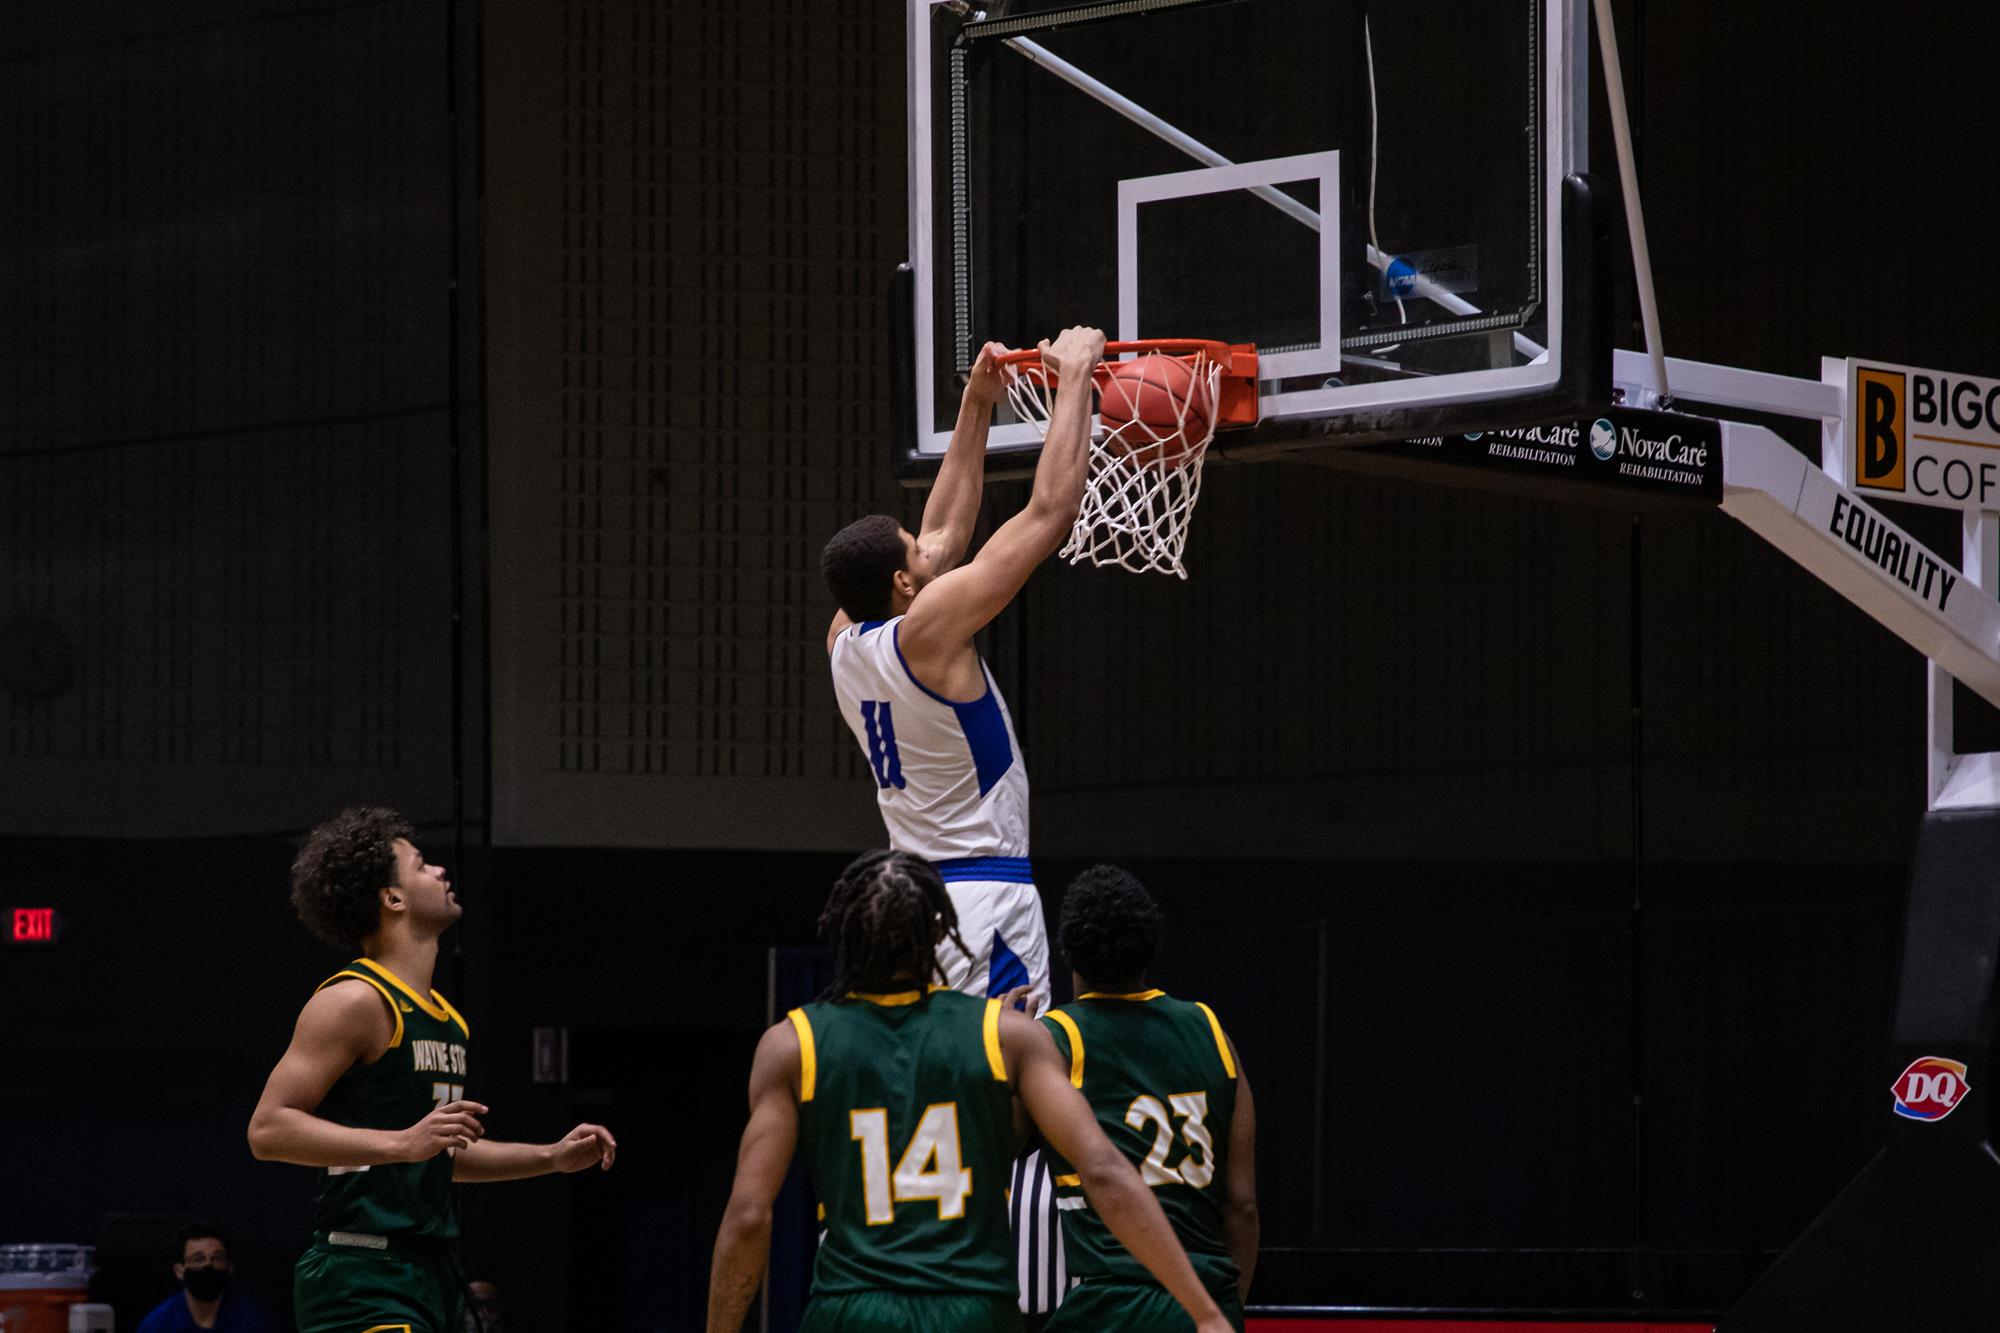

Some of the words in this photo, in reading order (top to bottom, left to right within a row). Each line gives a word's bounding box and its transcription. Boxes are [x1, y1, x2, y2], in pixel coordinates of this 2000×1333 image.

[1487, 426, 1580, 448] vaCare
[1618, 427, 1708, 467] NovaCare
[1865, 380, 1898, 479] B
[1488, 443, 1577, 466] REHABILITATION
[1619, 462, 1704, 485] REHABILITATION
[1912, 455, 1996, 503] COF
[1830, 493, 1956, 612] EQUALITY
[861, 700, 906, 790] 11
[14, 908, 52, 940] EXIT
[412, 1040, 450, 1072] WAYNE
[1905, 1072, 1956, 1107] DQ
[1125, 1091, 1215, 1188] 23
[850, 1102, 972, 1226] 14
